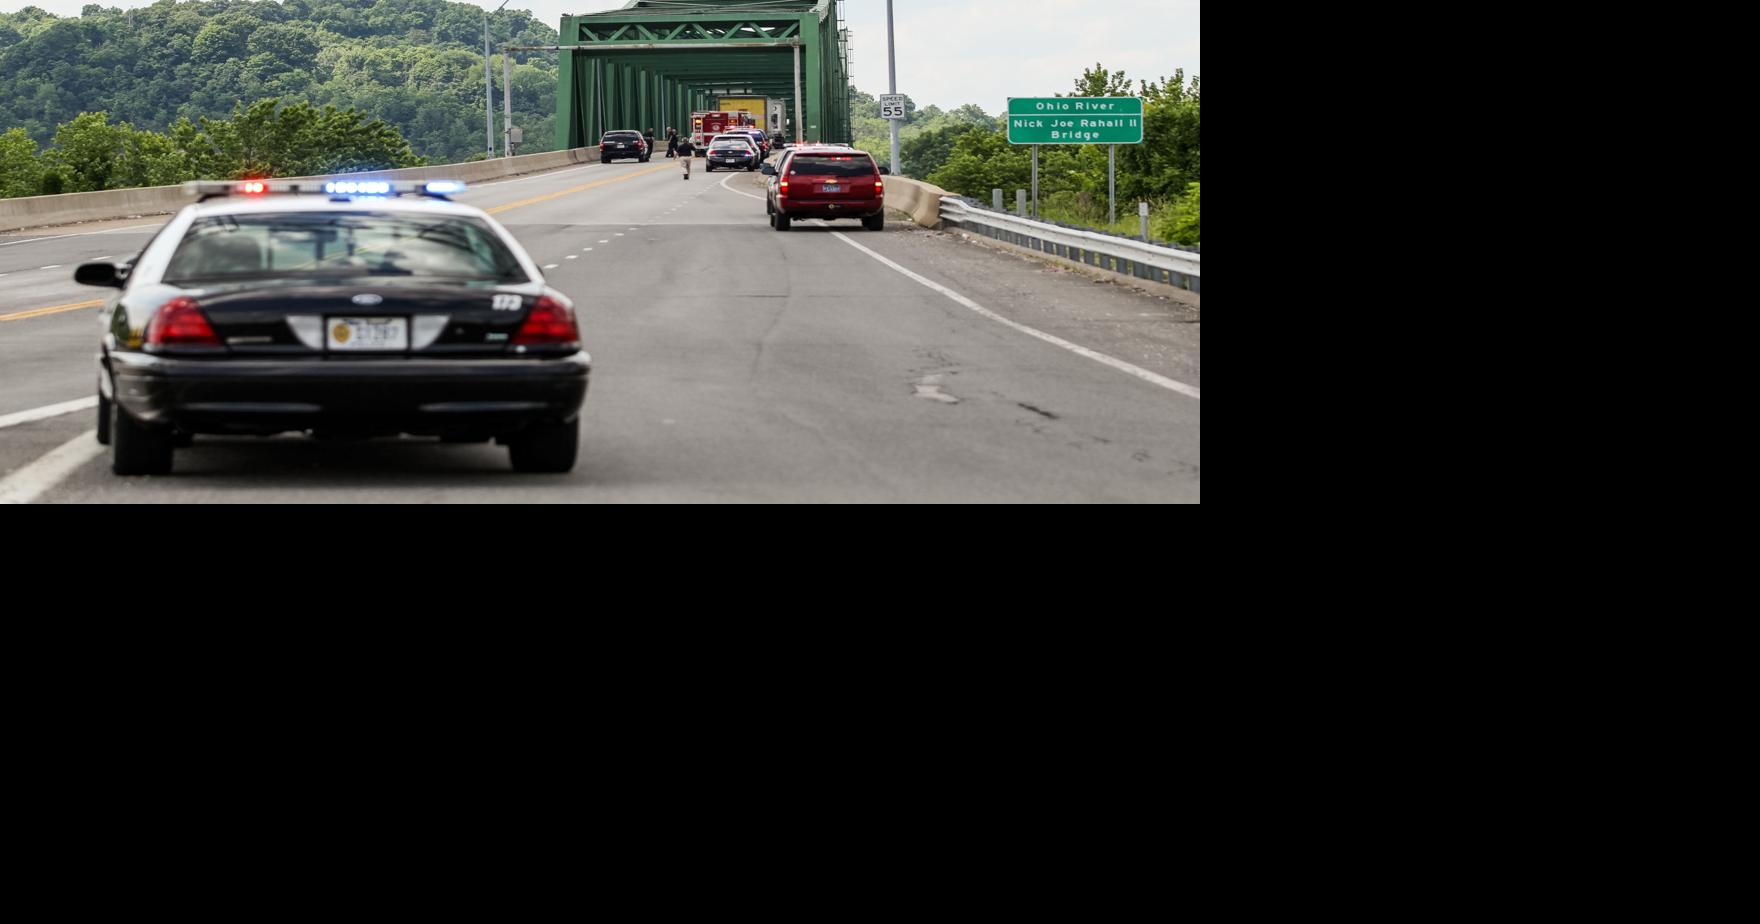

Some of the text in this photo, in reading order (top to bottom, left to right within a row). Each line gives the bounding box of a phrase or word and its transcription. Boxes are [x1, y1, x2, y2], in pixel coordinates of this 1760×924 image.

[1036, 102, 1115, 110] Ohio River
[883, 106, 902, 116] 55
[1014, 120, 1043, 128] Nick
[1050, 120, 1074, 128] Joe
[1080, 119, 1123, 127] Rahall
[1052, 130, 1100, 140] Bridge
